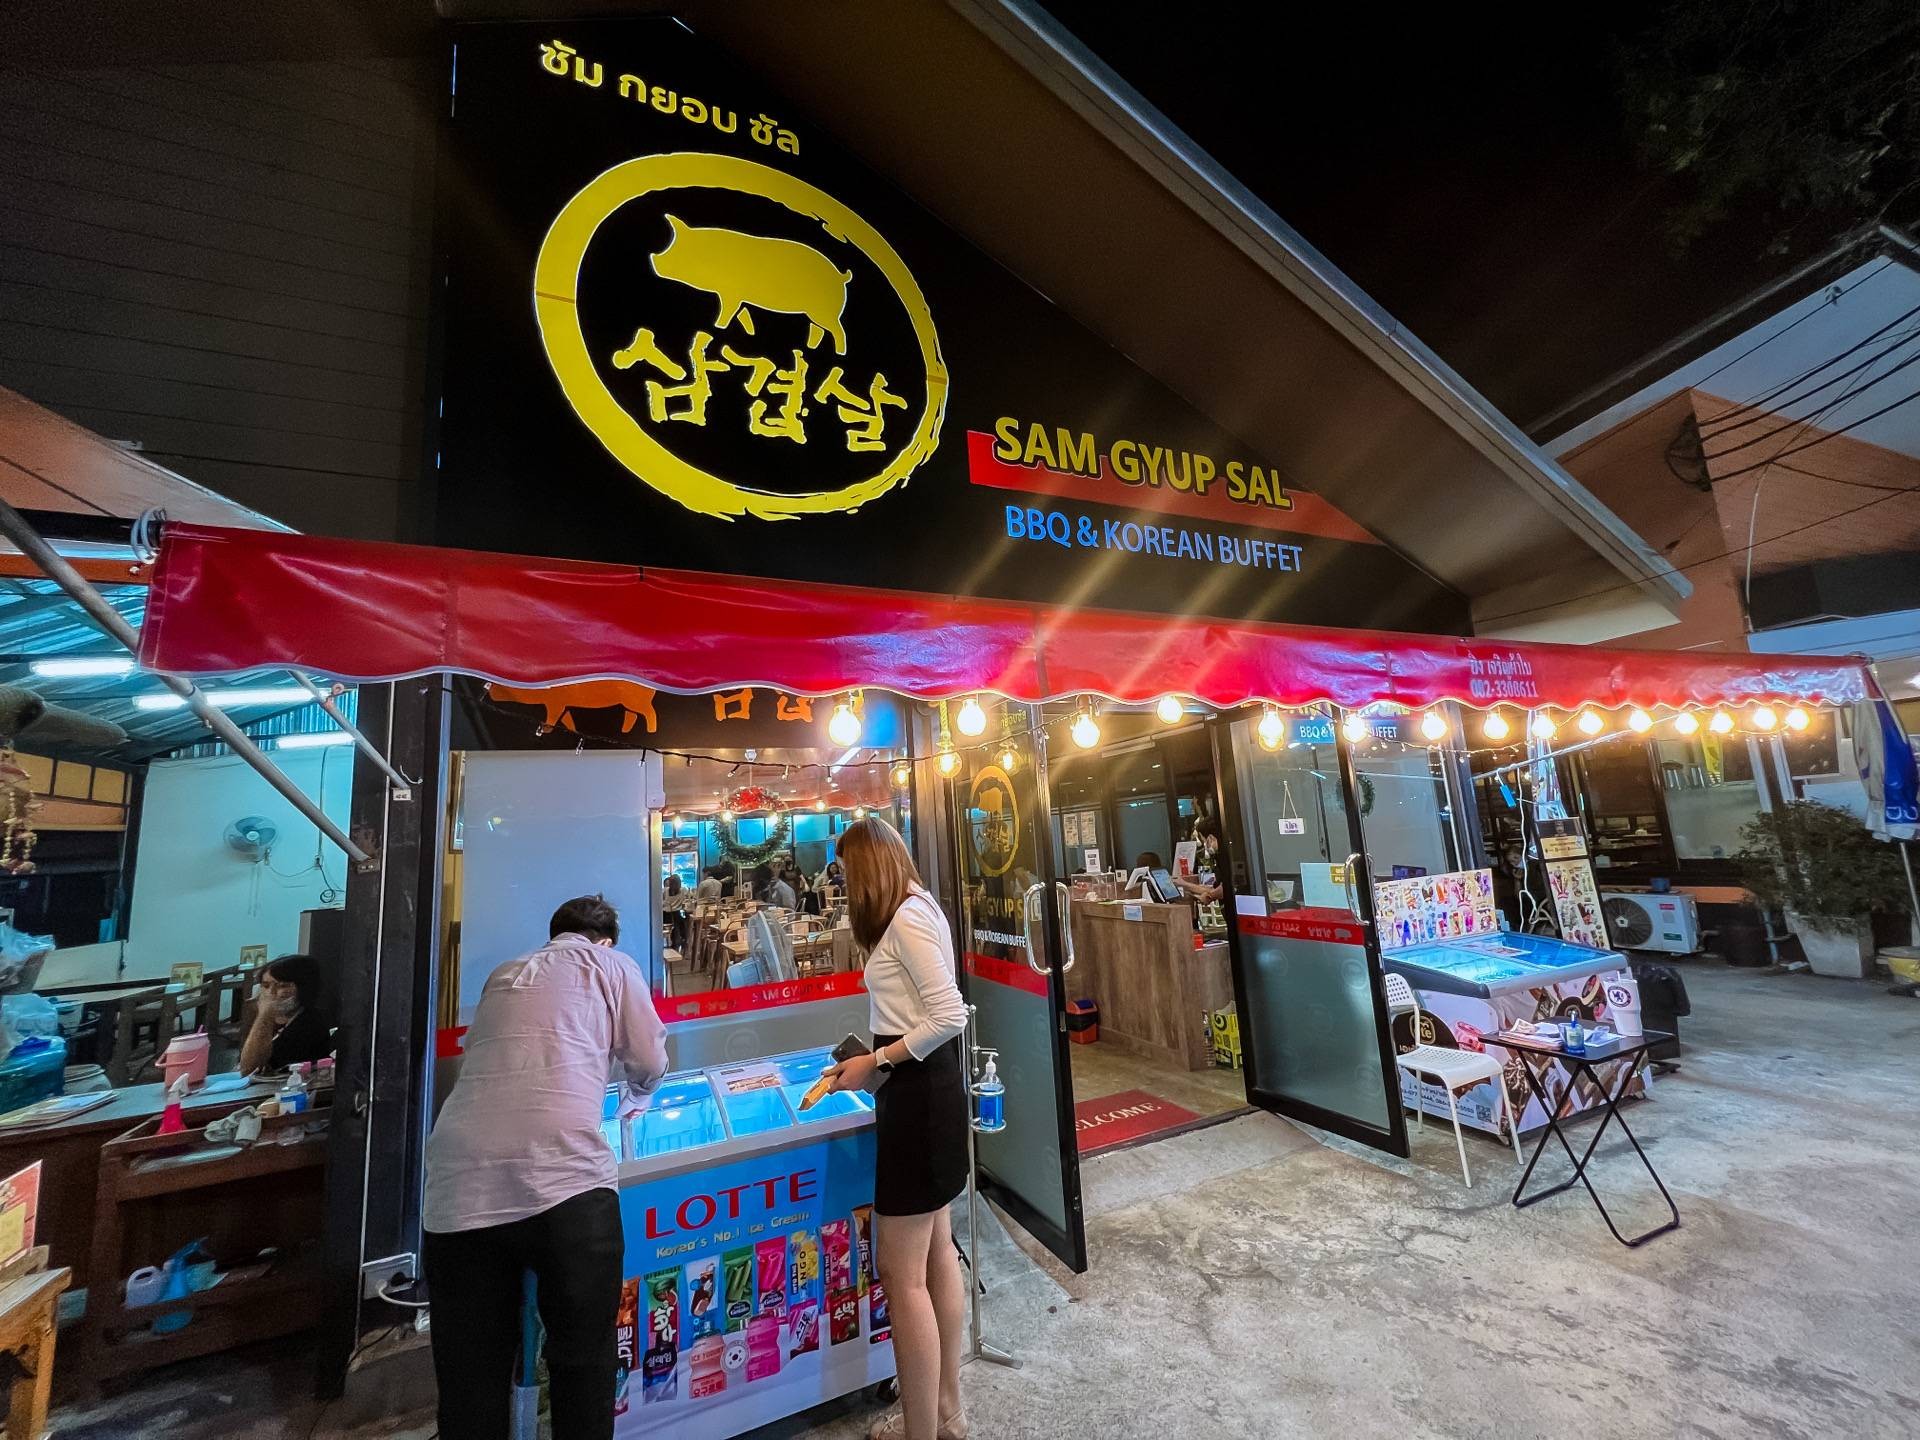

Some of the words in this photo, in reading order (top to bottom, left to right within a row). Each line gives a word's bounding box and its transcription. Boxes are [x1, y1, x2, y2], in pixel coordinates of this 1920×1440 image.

[540, 39, 603, 88] ซัม
[619, 74, 737, 133] กยอบ
[749, 113, 800, 156] ซัล
[612, 328, 908, 451] 삼겹살
[994, 416, 1098, 475] SAM
[1110, 439, 1216, 493] GYUP
[1226, 461, 1291, 507] SAL
[1005, 505, 1071, 548] BBQ
[1076, 515, 1099, 548] &
[1103, 518, 1214, 562] KOREAN
[1217, 534, 1303, 572] BUFFET
[1300, 725, 1320, 738] BBQ
[1370, 726, 1397, 738] UFFET
[1009, 935, 1028, 947] BUFFE
[1076, 1102, 1162, 1131] ELCOME
[645, 1168, 817, 1240] LOTTE
[656, 1236, 708, 1259] Korea's
